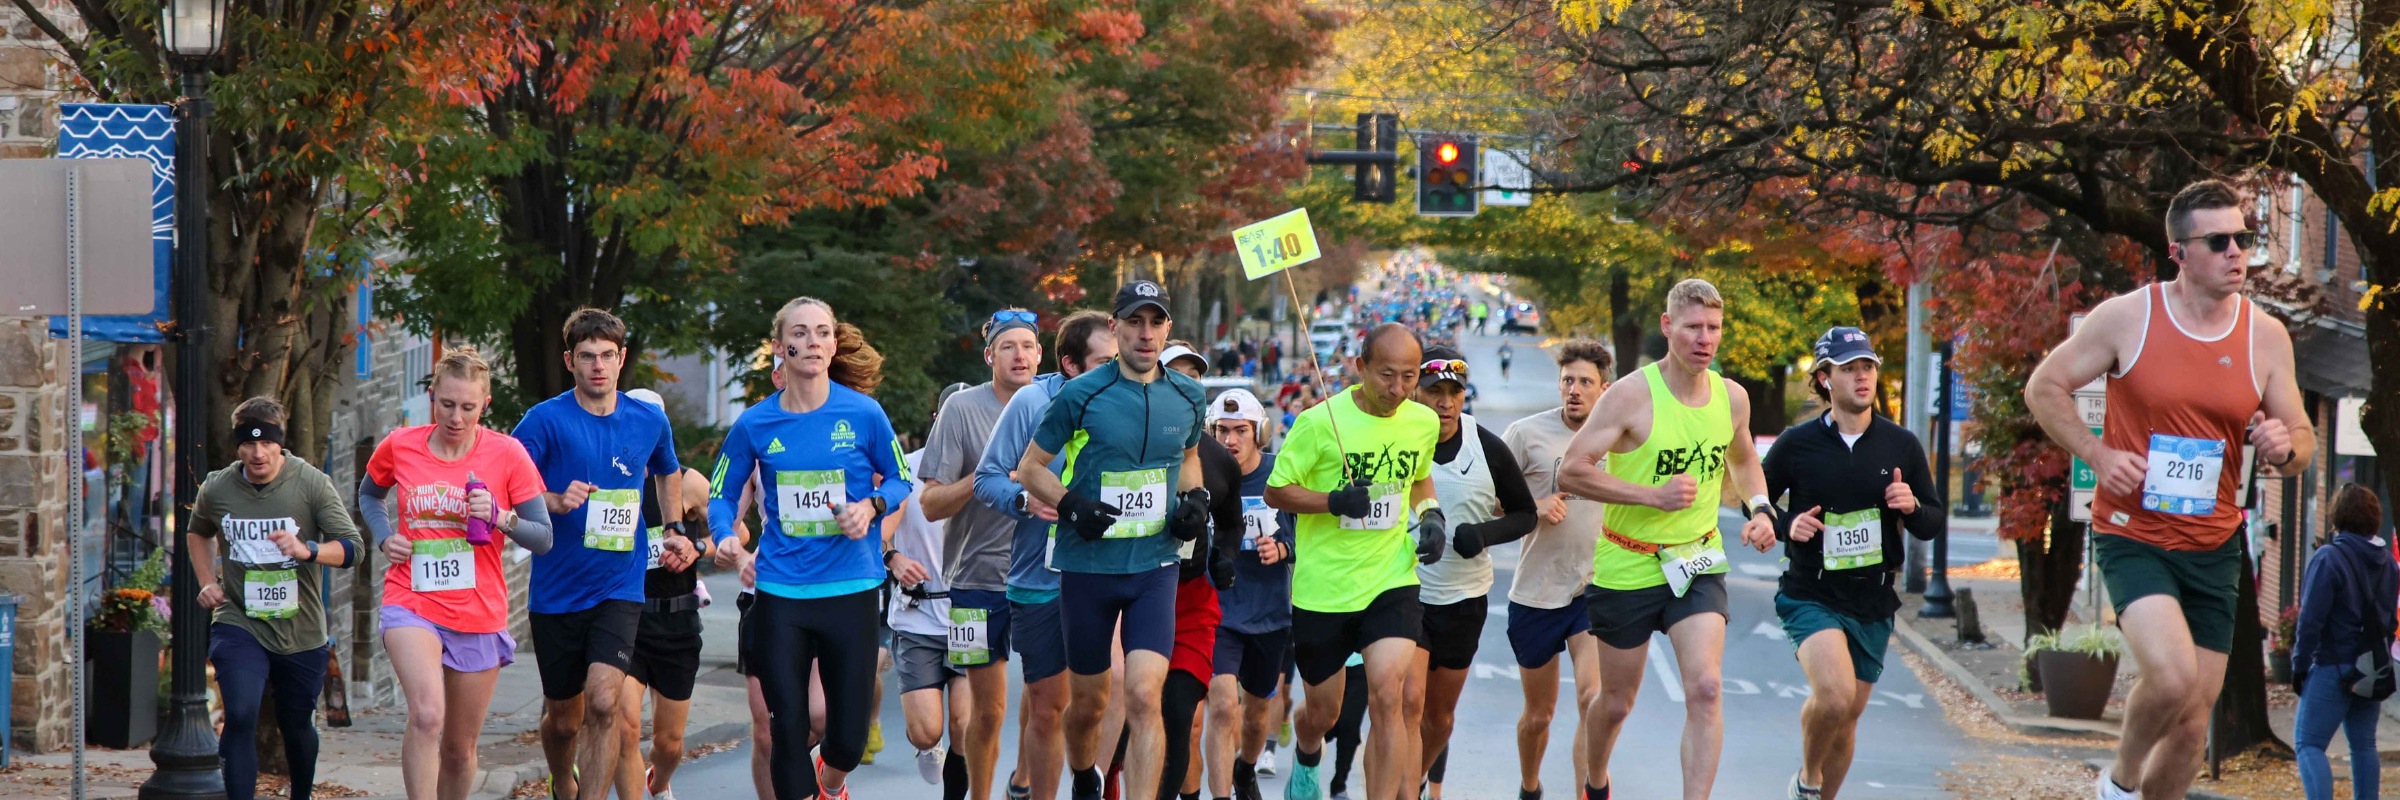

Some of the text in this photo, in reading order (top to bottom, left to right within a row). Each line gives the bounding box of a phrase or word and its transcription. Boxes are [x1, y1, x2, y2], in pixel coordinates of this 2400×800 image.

[1252, 233, 1301, 268] 1:40
[2088, 412, 2104, 423] RO
[1342, 442, 1419, 480] BEAST
[820, 469, 843, 484] 13.1
[1145, 468, 1164, 485] 13.1
[2080, 469, 2096, 481] ST
[2167, 460, 2204, 481] 2216
[416, 483, 467, 499] RUN THE
[793, 490, 830, 509] 1454
[411, 494, 466, 518] VINEYARDS
[1117, 491, 1153, 510] 1243
[602, 508, 632, 525] 1258
[1366, 501, 1390, 518] 181
[649, 528, 663, 539] 13.
[1836, 528, 1869, 546] 1350
[1836, 544, 1871, 553] Silverstein
[423, 560, 460, 579] 1153
[1678, 556, 1713, 579] 1358
[257, 586, 287, 601] 1266
[949, 625, 975, 642] 1110
